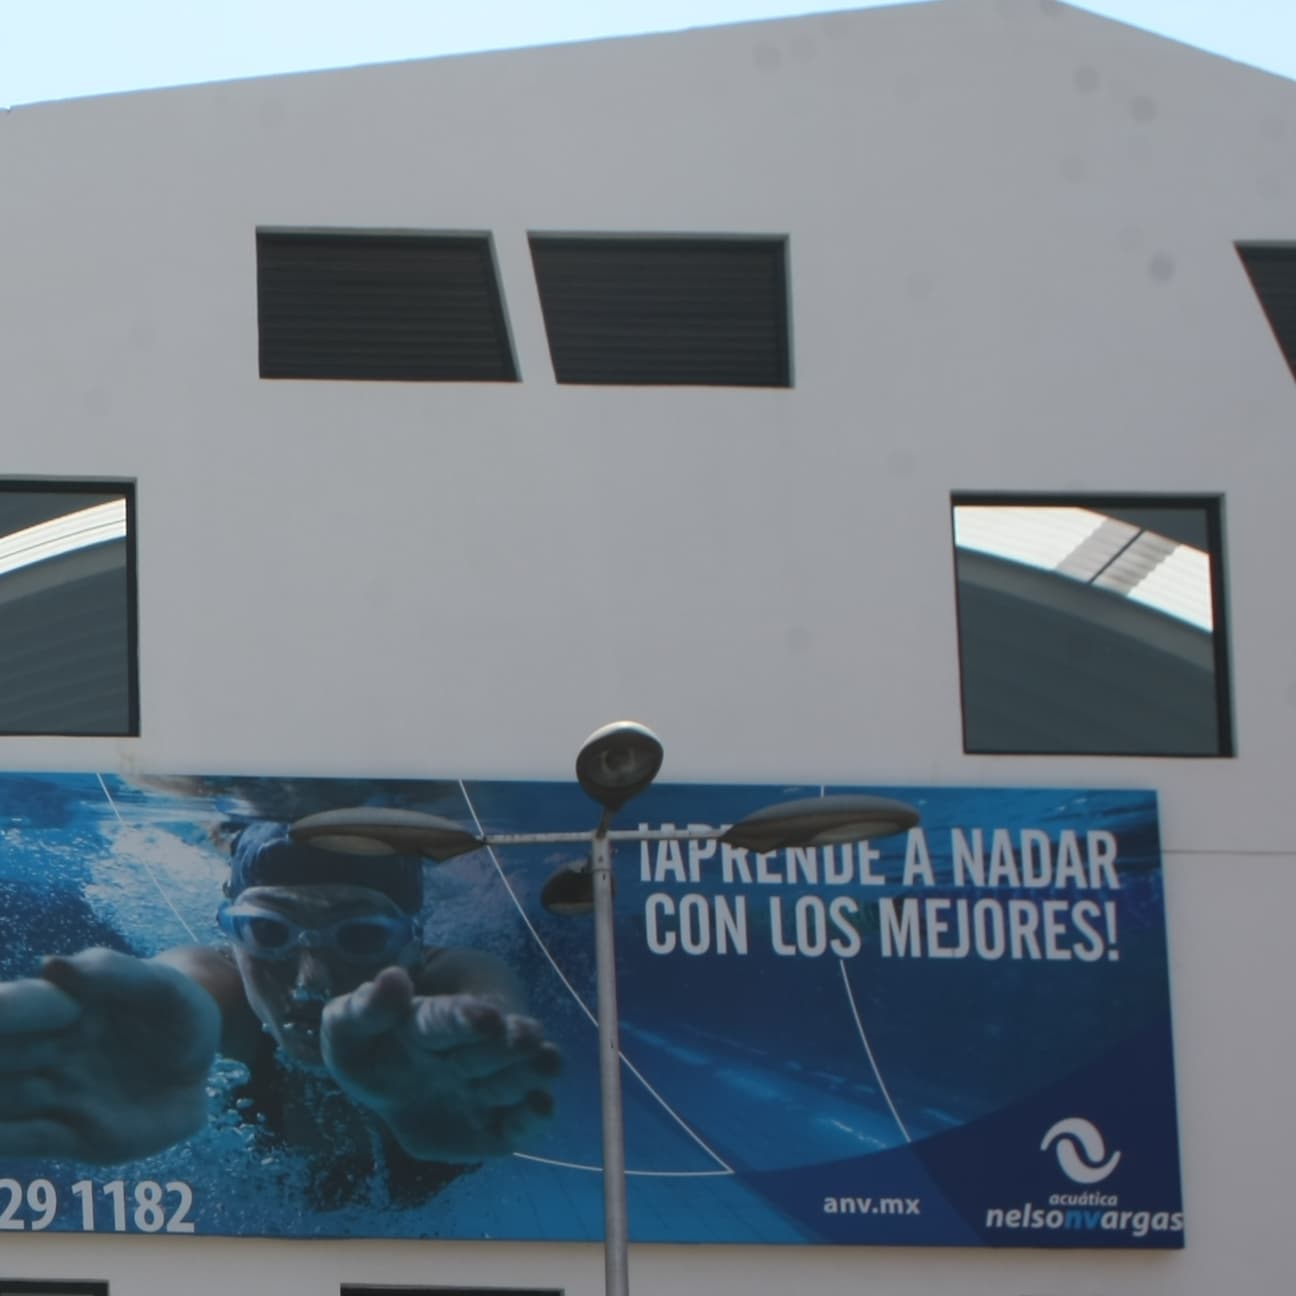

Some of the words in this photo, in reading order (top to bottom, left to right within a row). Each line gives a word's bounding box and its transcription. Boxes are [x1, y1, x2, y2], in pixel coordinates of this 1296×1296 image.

[902, 826, 936, 886] A
[952, 829, 1120, 889] NADAR
[645, 893, 749, 955] CON
[770, 895, 862, 959] LOS
[879, 897, 1120, 961] MEJORES!
[72, 1180, 196, 1233] 1182
[823, 1195, 922, 1216] anv.mx
[1049, 1190, 1119, 1208] acuática
